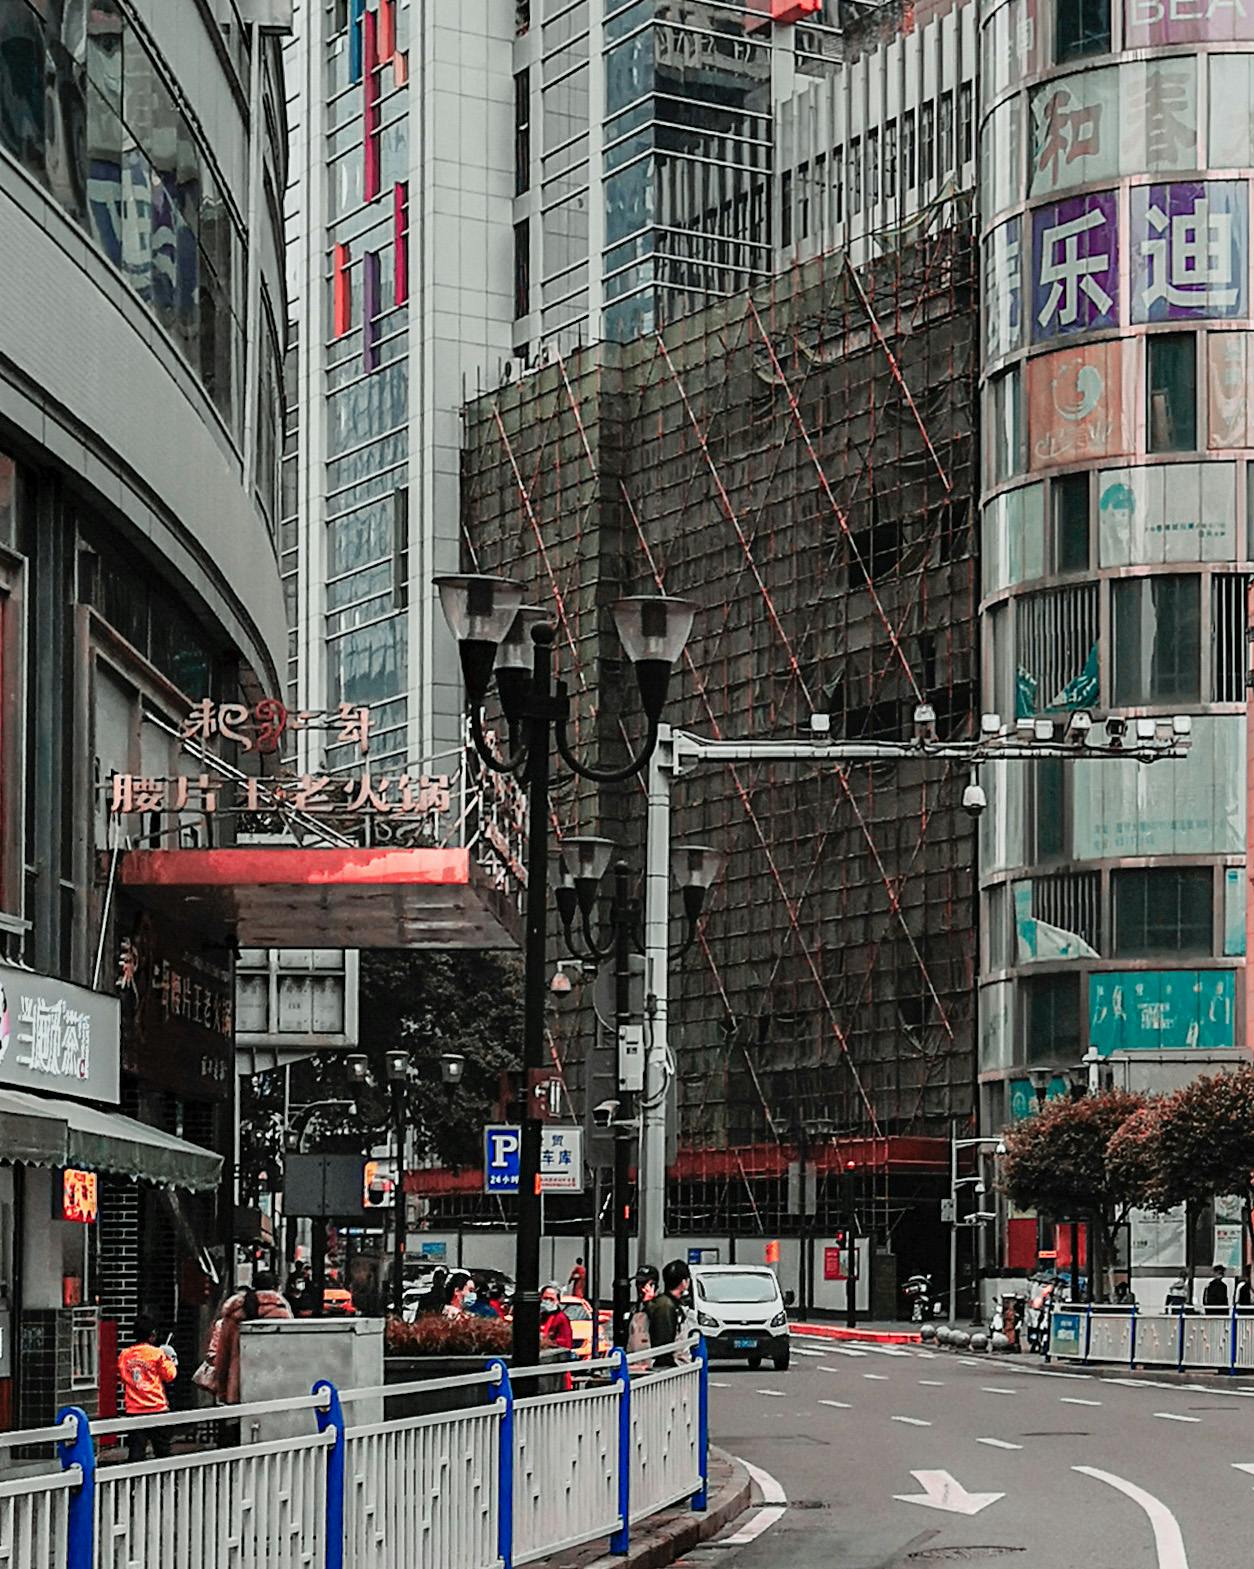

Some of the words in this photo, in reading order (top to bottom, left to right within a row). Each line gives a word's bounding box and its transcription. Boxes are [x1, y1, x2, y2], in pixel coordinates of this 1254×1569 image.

[111, 772, 451, 814] 腰片王老火锅
[491, 1135, 518, 1167] P
